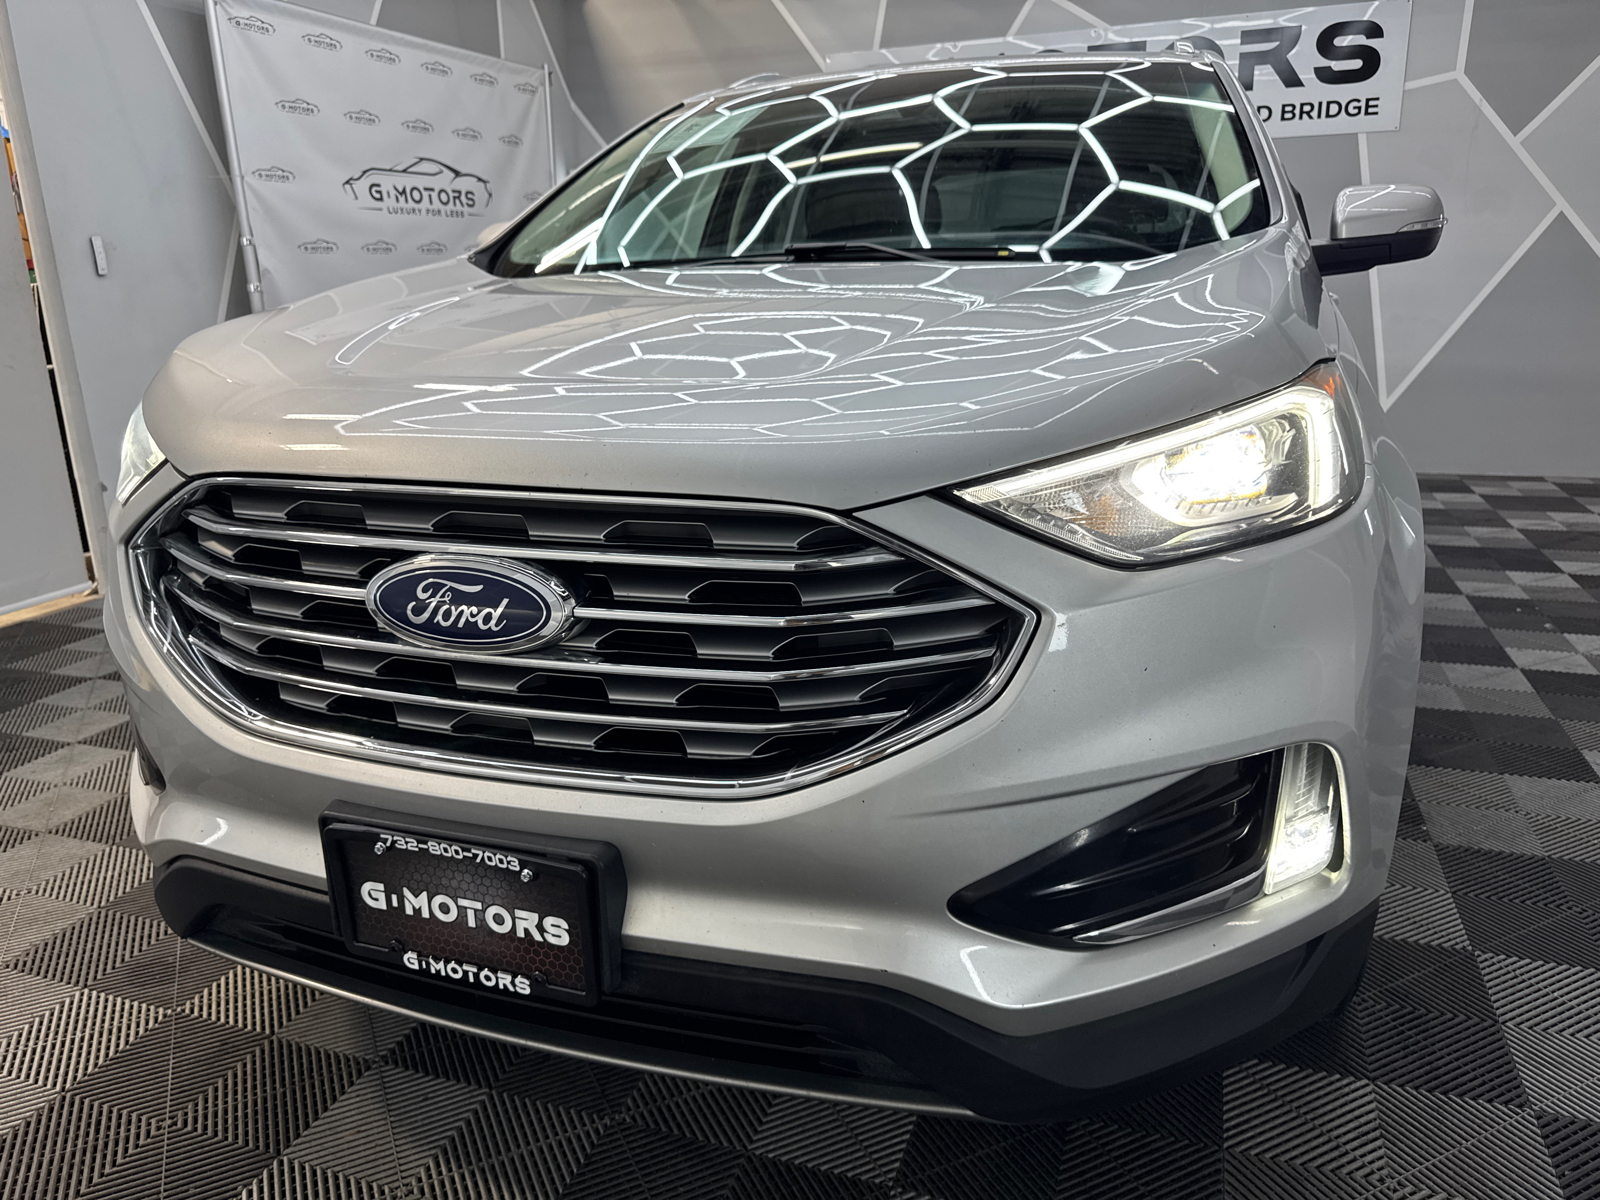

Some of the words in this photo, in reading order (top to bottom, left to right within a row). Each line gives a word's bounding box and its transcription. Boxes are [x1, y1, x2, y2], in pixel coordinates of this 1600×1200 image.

[1280, 97, 1380, 122] BRIDGE
[387, 206, 422, 216] LUXURY
[426, 209, 442, 217] FOR
[445, 210, 465, 219] LESS
[406, 578, 510, 632] Ford
[379, 833, 521, 872] 732-800-7003
